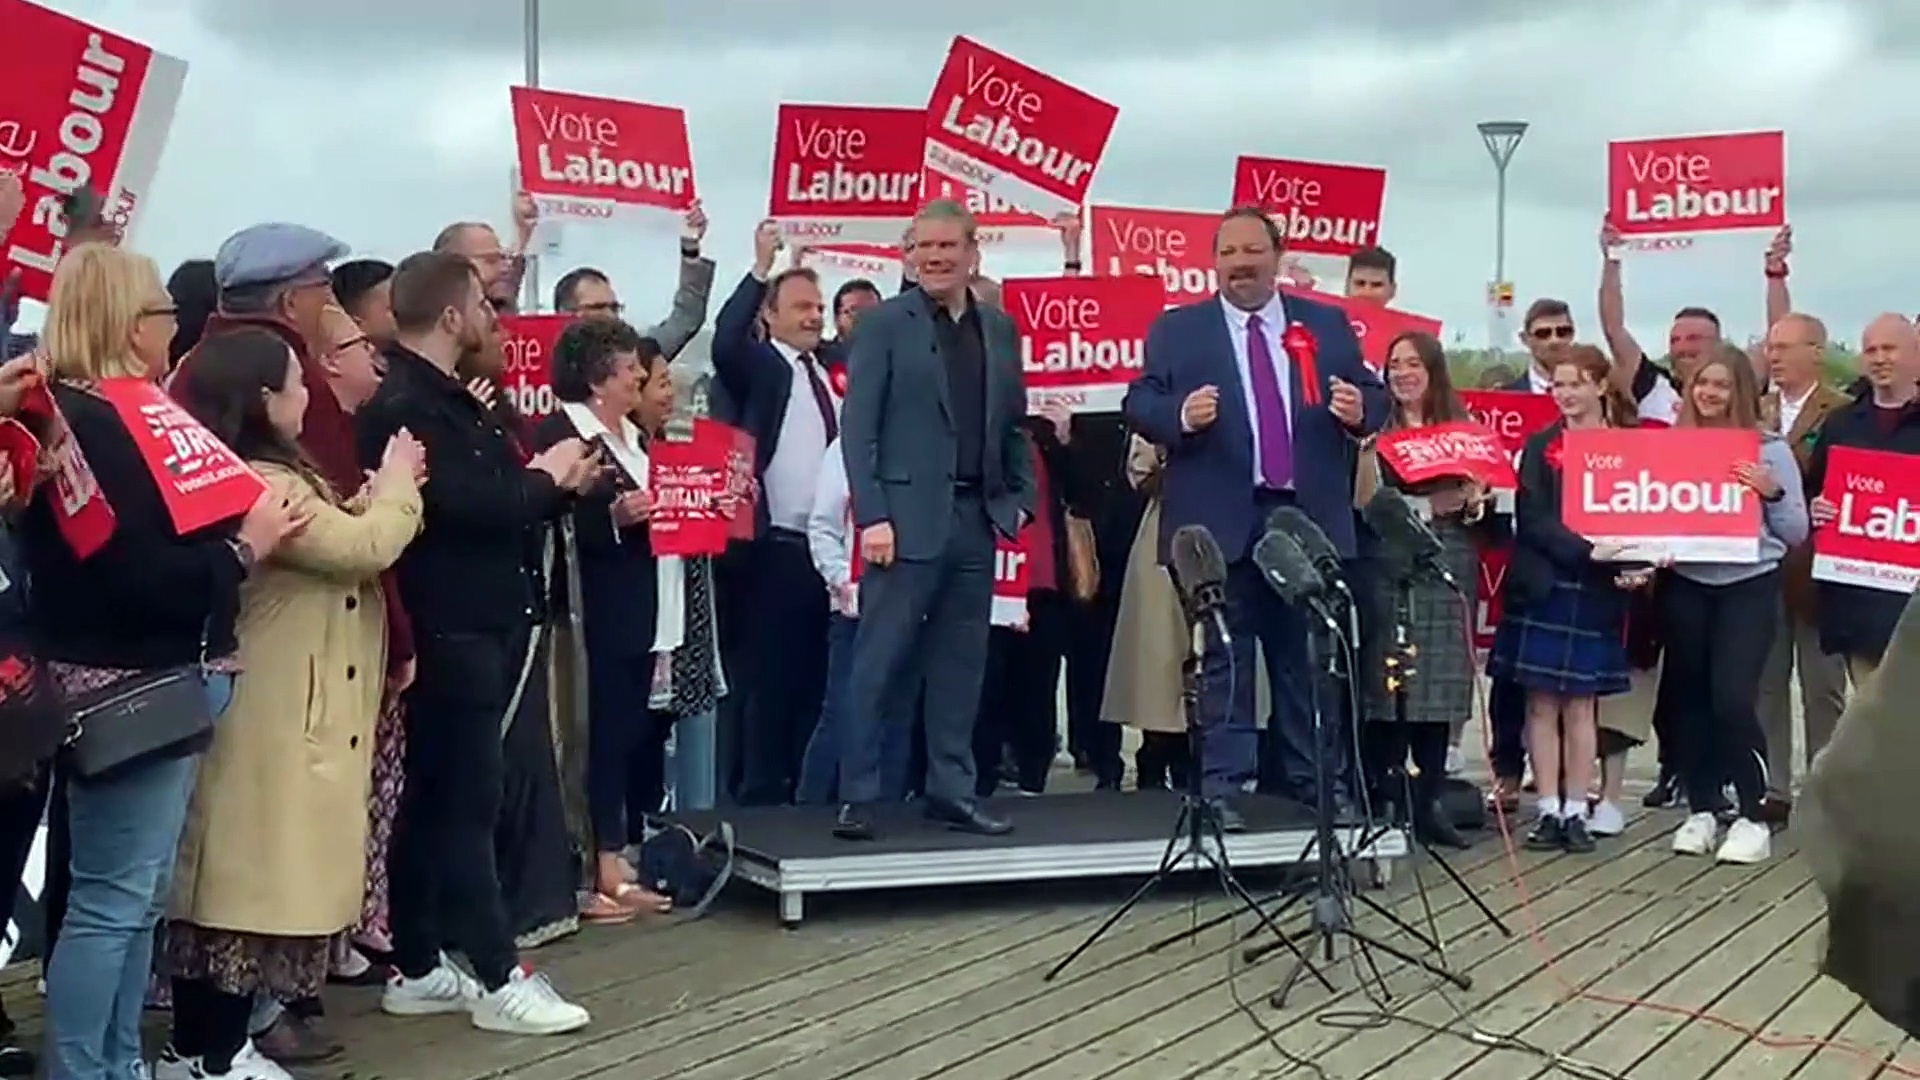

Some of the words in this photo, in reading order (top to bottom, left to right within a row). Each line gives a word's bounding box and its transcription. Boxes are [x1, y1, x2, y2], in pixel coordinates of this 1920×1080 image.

[965, 55, 1043, 123] Vote
[531, 102, 618, 147] Vote
[795, 119, 866, 160] Vote
[942, 94, 1093, 187] Labour
[7, 33, 126, 274] Labour
[537, 143, 690, 195] Labour
[1626, 150, 1711, 184] Vote
[787, 162, 918, 202] Labour
[1252, 168, 1322, 206] Vote
[1626, 184, 1781, 221] Labour
[1107, 217, 1187, 258] Vote
[1268, 206, 1376, 246] abour
[1020, 290, 1100, 331] Vote
[500, 336, 542, 374] ote
[1021, 333, 1145, 373] Labou
[1584, 453, 1623, 470] Vote
[1583, 470, 1747, 514] Labour
[1847, 474, 1886, 494] Vote
[1839, 493, 1920, 543] Lab
